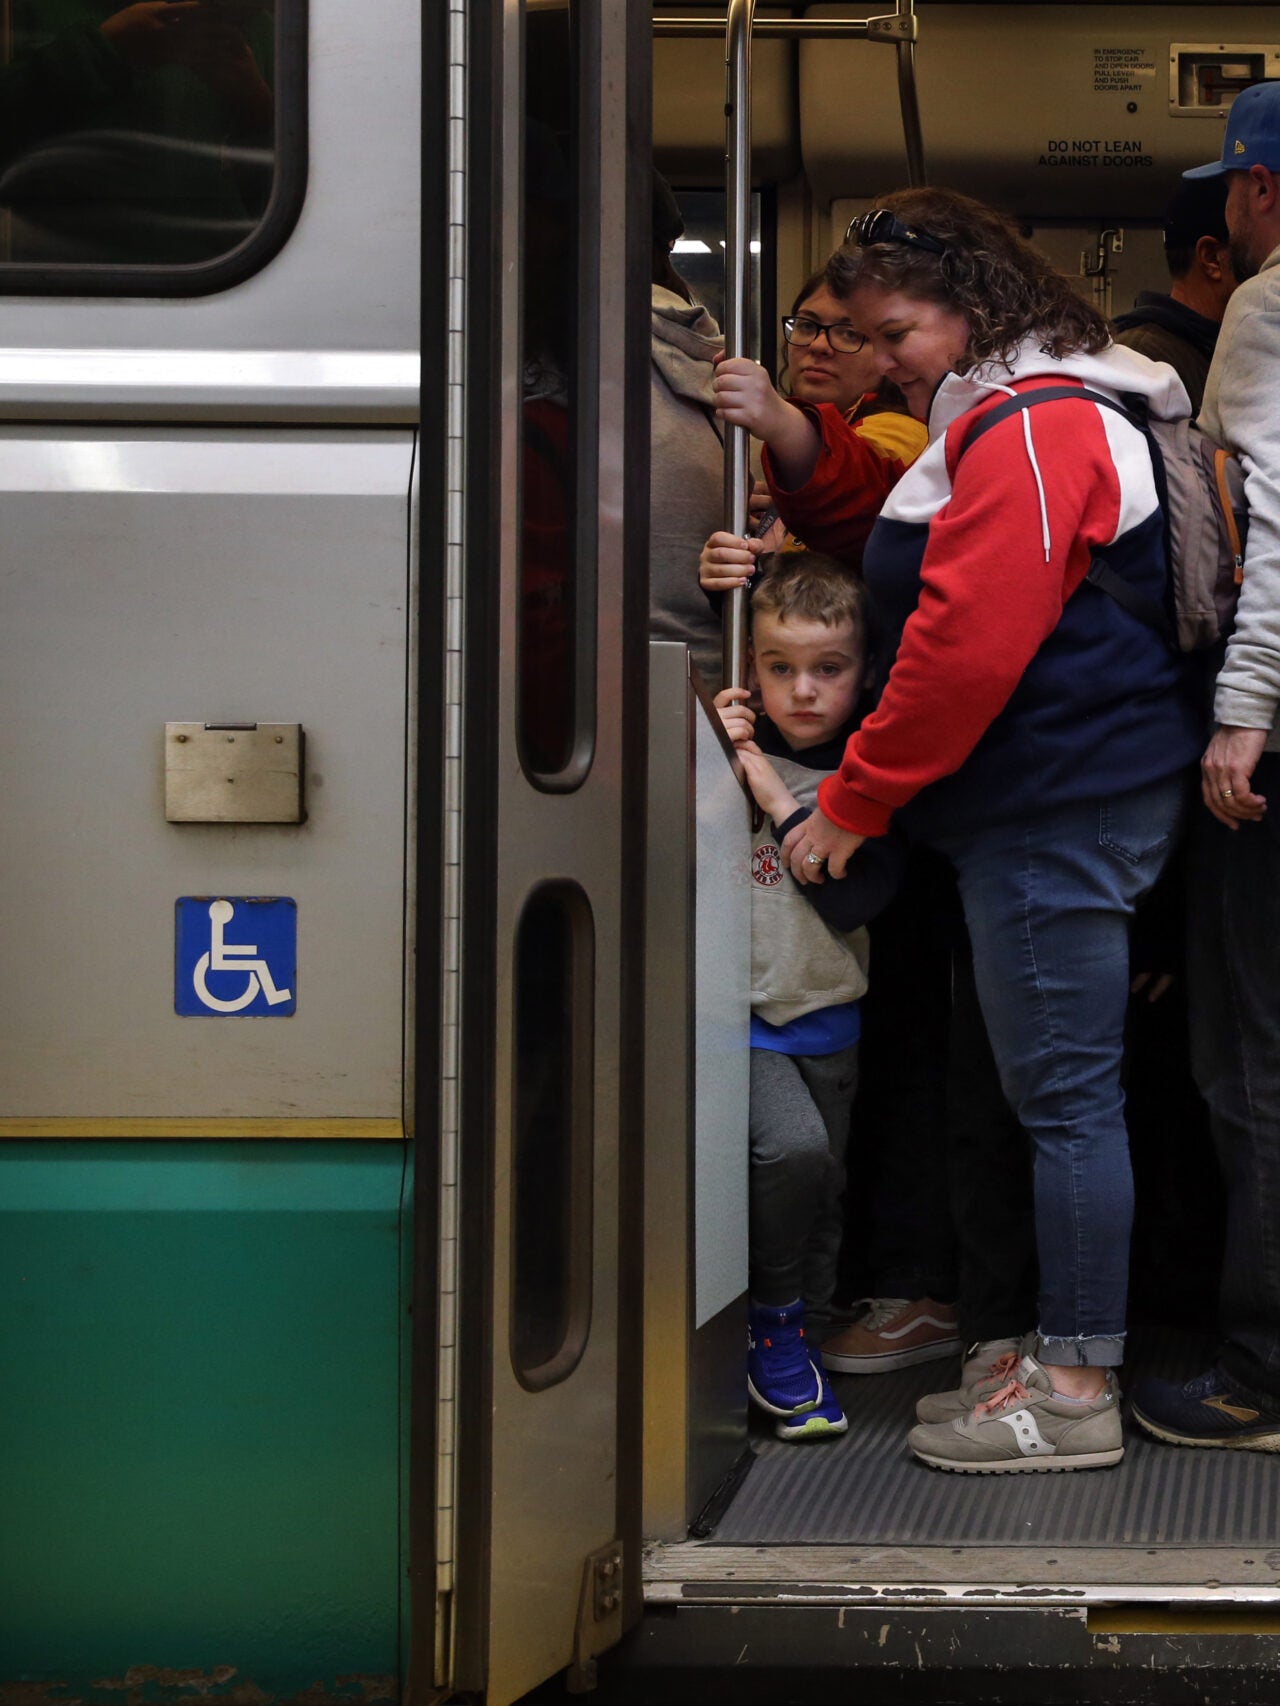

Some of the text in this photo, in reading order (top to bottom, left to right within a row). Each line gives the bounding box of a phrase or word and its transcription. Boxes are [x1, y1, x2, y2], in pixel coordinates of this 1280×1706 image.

[1048, 141, 1142, 153] DO NOT LEAN
[1038, 155, 1153, 167] AGAINST DOORS
[754, 870, 783, 884] RED SOX
